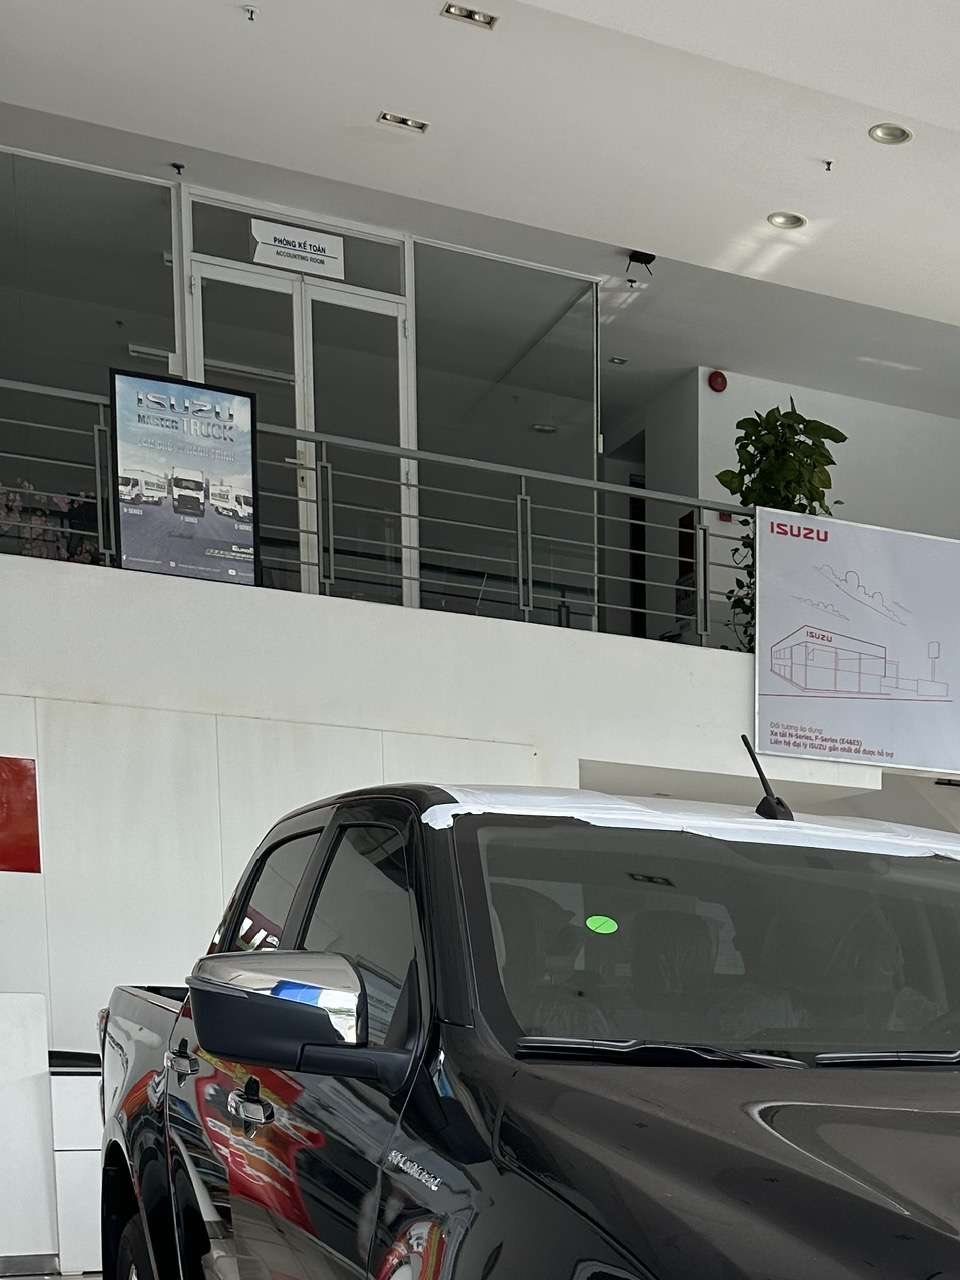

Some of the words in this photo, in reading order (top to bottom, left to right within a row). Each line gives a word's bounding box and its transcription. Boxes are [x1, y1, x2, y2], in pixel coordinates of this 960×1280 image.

[273, 235, 296, 248] PHÒNG
[298, 241, 307, 250] KẾ
[309, 243, 326, 254] TOÁN
[276, 249, 309, 262] ACCOUNTING
[310, 257, 325, 265] ROOM
[137, 391, 234, 422] ISUZU
[137, 414, 179, 430] MASTER
[182, 417, 234, 442] TRUCK
[770, 521, 829, 542] ISUZU
[806, 631, 833, 642] ISUZU
[809, 743, 827, 751] ISUZU
